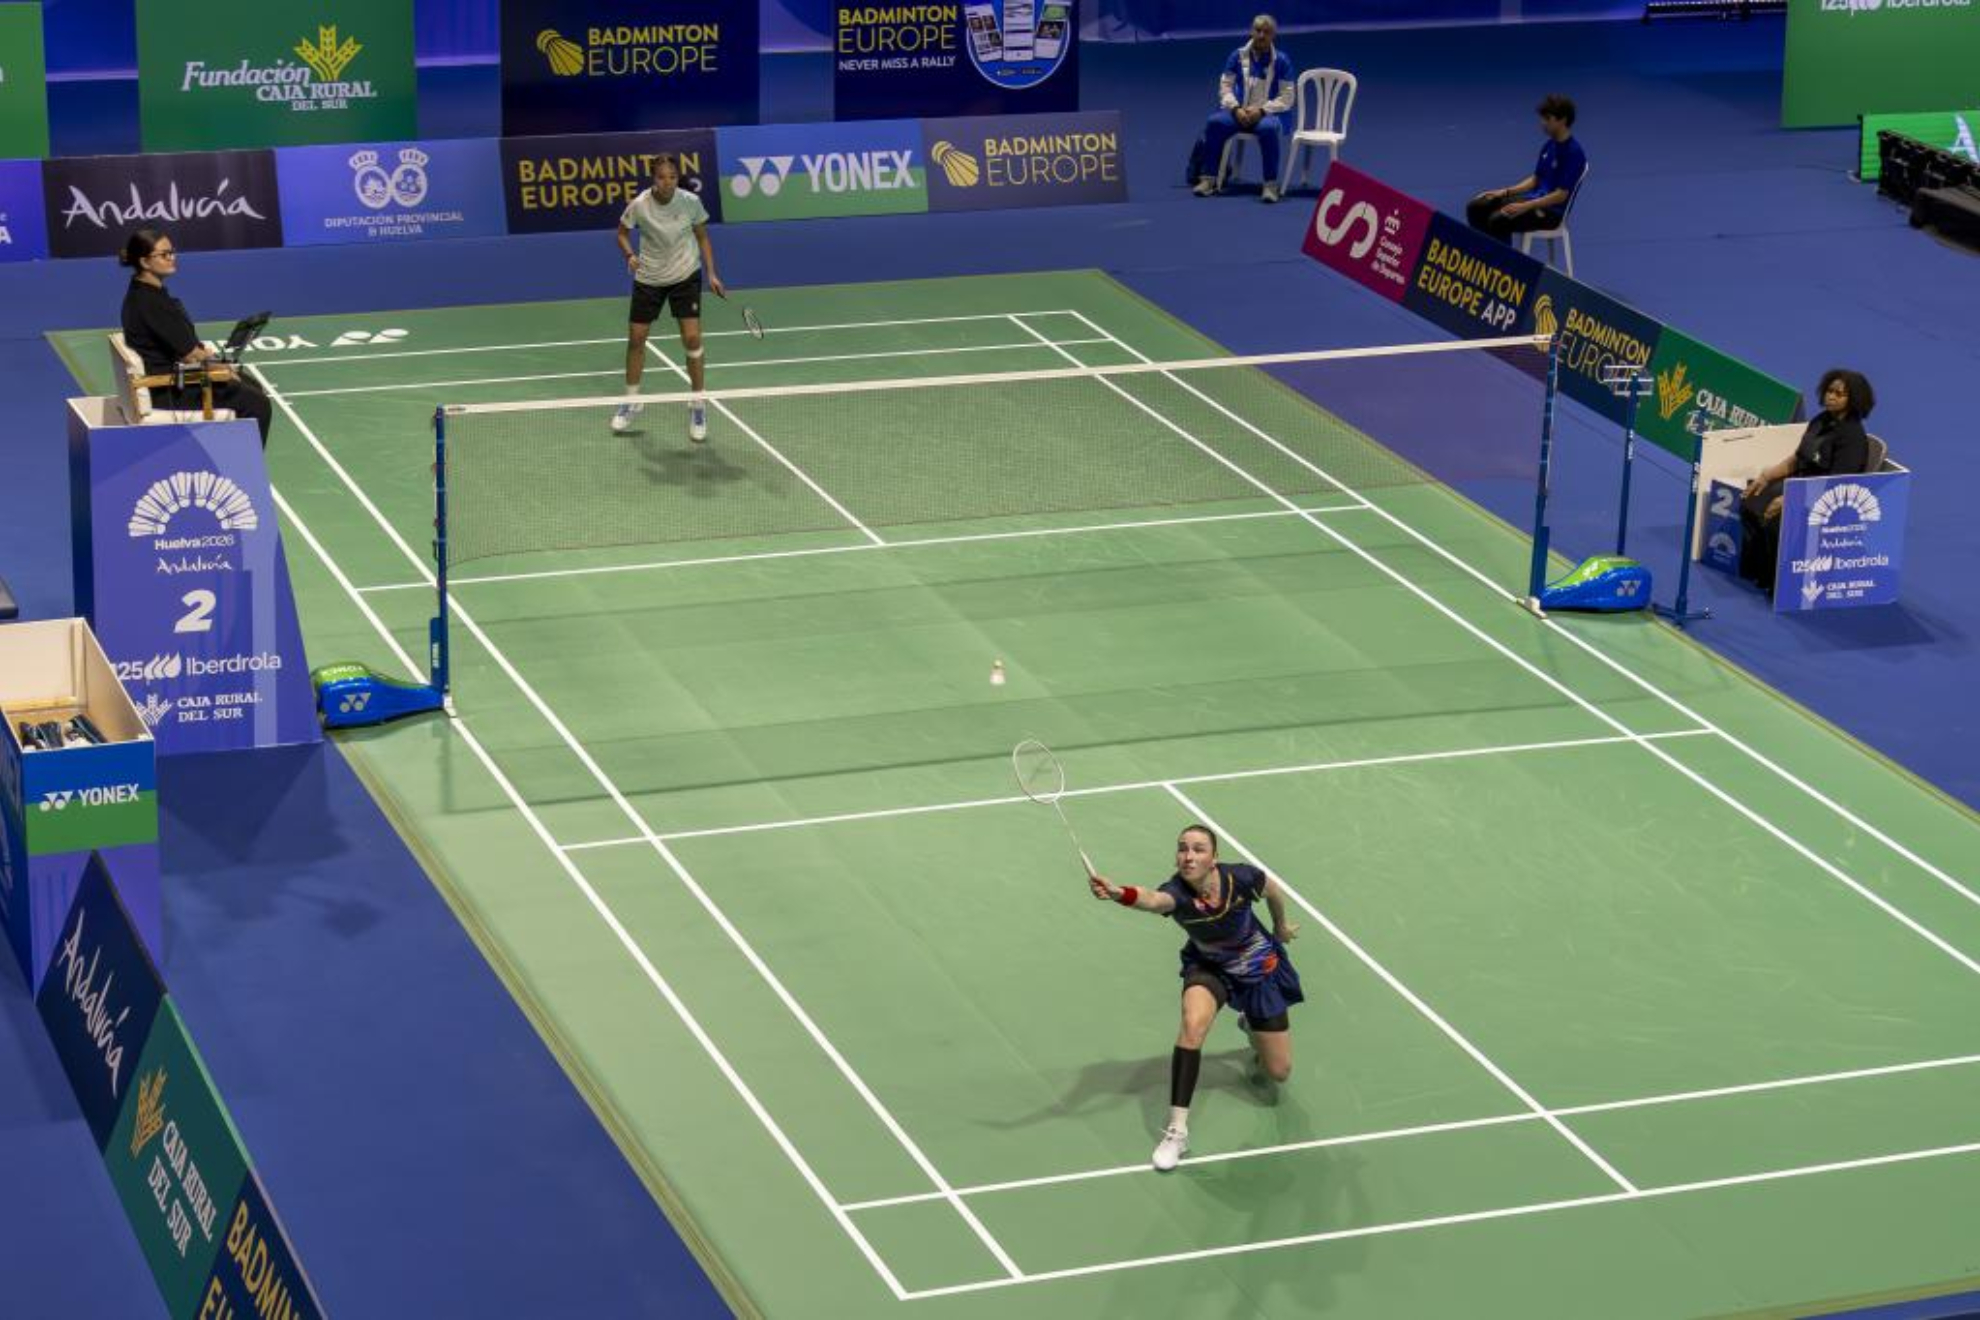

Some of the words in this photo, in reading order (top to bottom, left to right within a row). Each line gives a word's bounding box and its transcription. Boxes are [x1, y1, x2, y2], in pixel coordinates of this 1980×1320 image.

[838, 5, 957, 26] BADMINTON
[588, 24, 719, 46] BADMINTON
[838, 25, 956, 53] EUROPE
[180, 59, 311, 91] Fundación
[588, 44, 719, 76] EUROPE
[838, 59, 879, 71] NEVER
[881, 58, 908, 69] MISS
[910, 57, 919, 68] A
[921, 56, 956, 67] RALLY
[256, 85, 307, 101] CAJA
[309, 81, 377, 99] RURAL
[292, 101, 318, 111] DEL
[321, 99, 348, 110] SUR
[984, 132, 1118, 157] BADMINTON
[518, 152, 700, 183] BADMINTN
[801, 150, 917, 192] YONEX
[986, 152, 1120, 187] EUROPE
[62, 178, 266, 229] Andalucía
[521, 181, 639, 209] EUROPE
[1427, 238, 1527, 306] BADMINTON
[1417, 265, 1484, 317] EUROPE
[1481, 299, 1516, 331] APP
[1565, 307, 1651, 364] BADMINTON
[1696, 389, 1727, 419] CAJA
[1711, 487, 1734, 518] 2
[154, 534, 235, 550] Huelva2026
[156, 553, 233, 575] Andalucía
[173, 589, 217, 633] 2
[186, 651, 283, 676] Iberdrola
[177, 696, 211, 708] CAJA
[215, 692, 263, 705] RURAL
[178, 709, 208, 722] DEL
[213, 707, 244, 720] SUR
[78, 783, 140, 807] YONEX
[57, 907, 130, 1099] Andalucía
[163, 1120, 188, 1180] CAJA
[182, 1161, 216, 1242] RURAL
[148, 1155, 172, 1214] DEL
[167, 1199, 192, 1258] SUR
